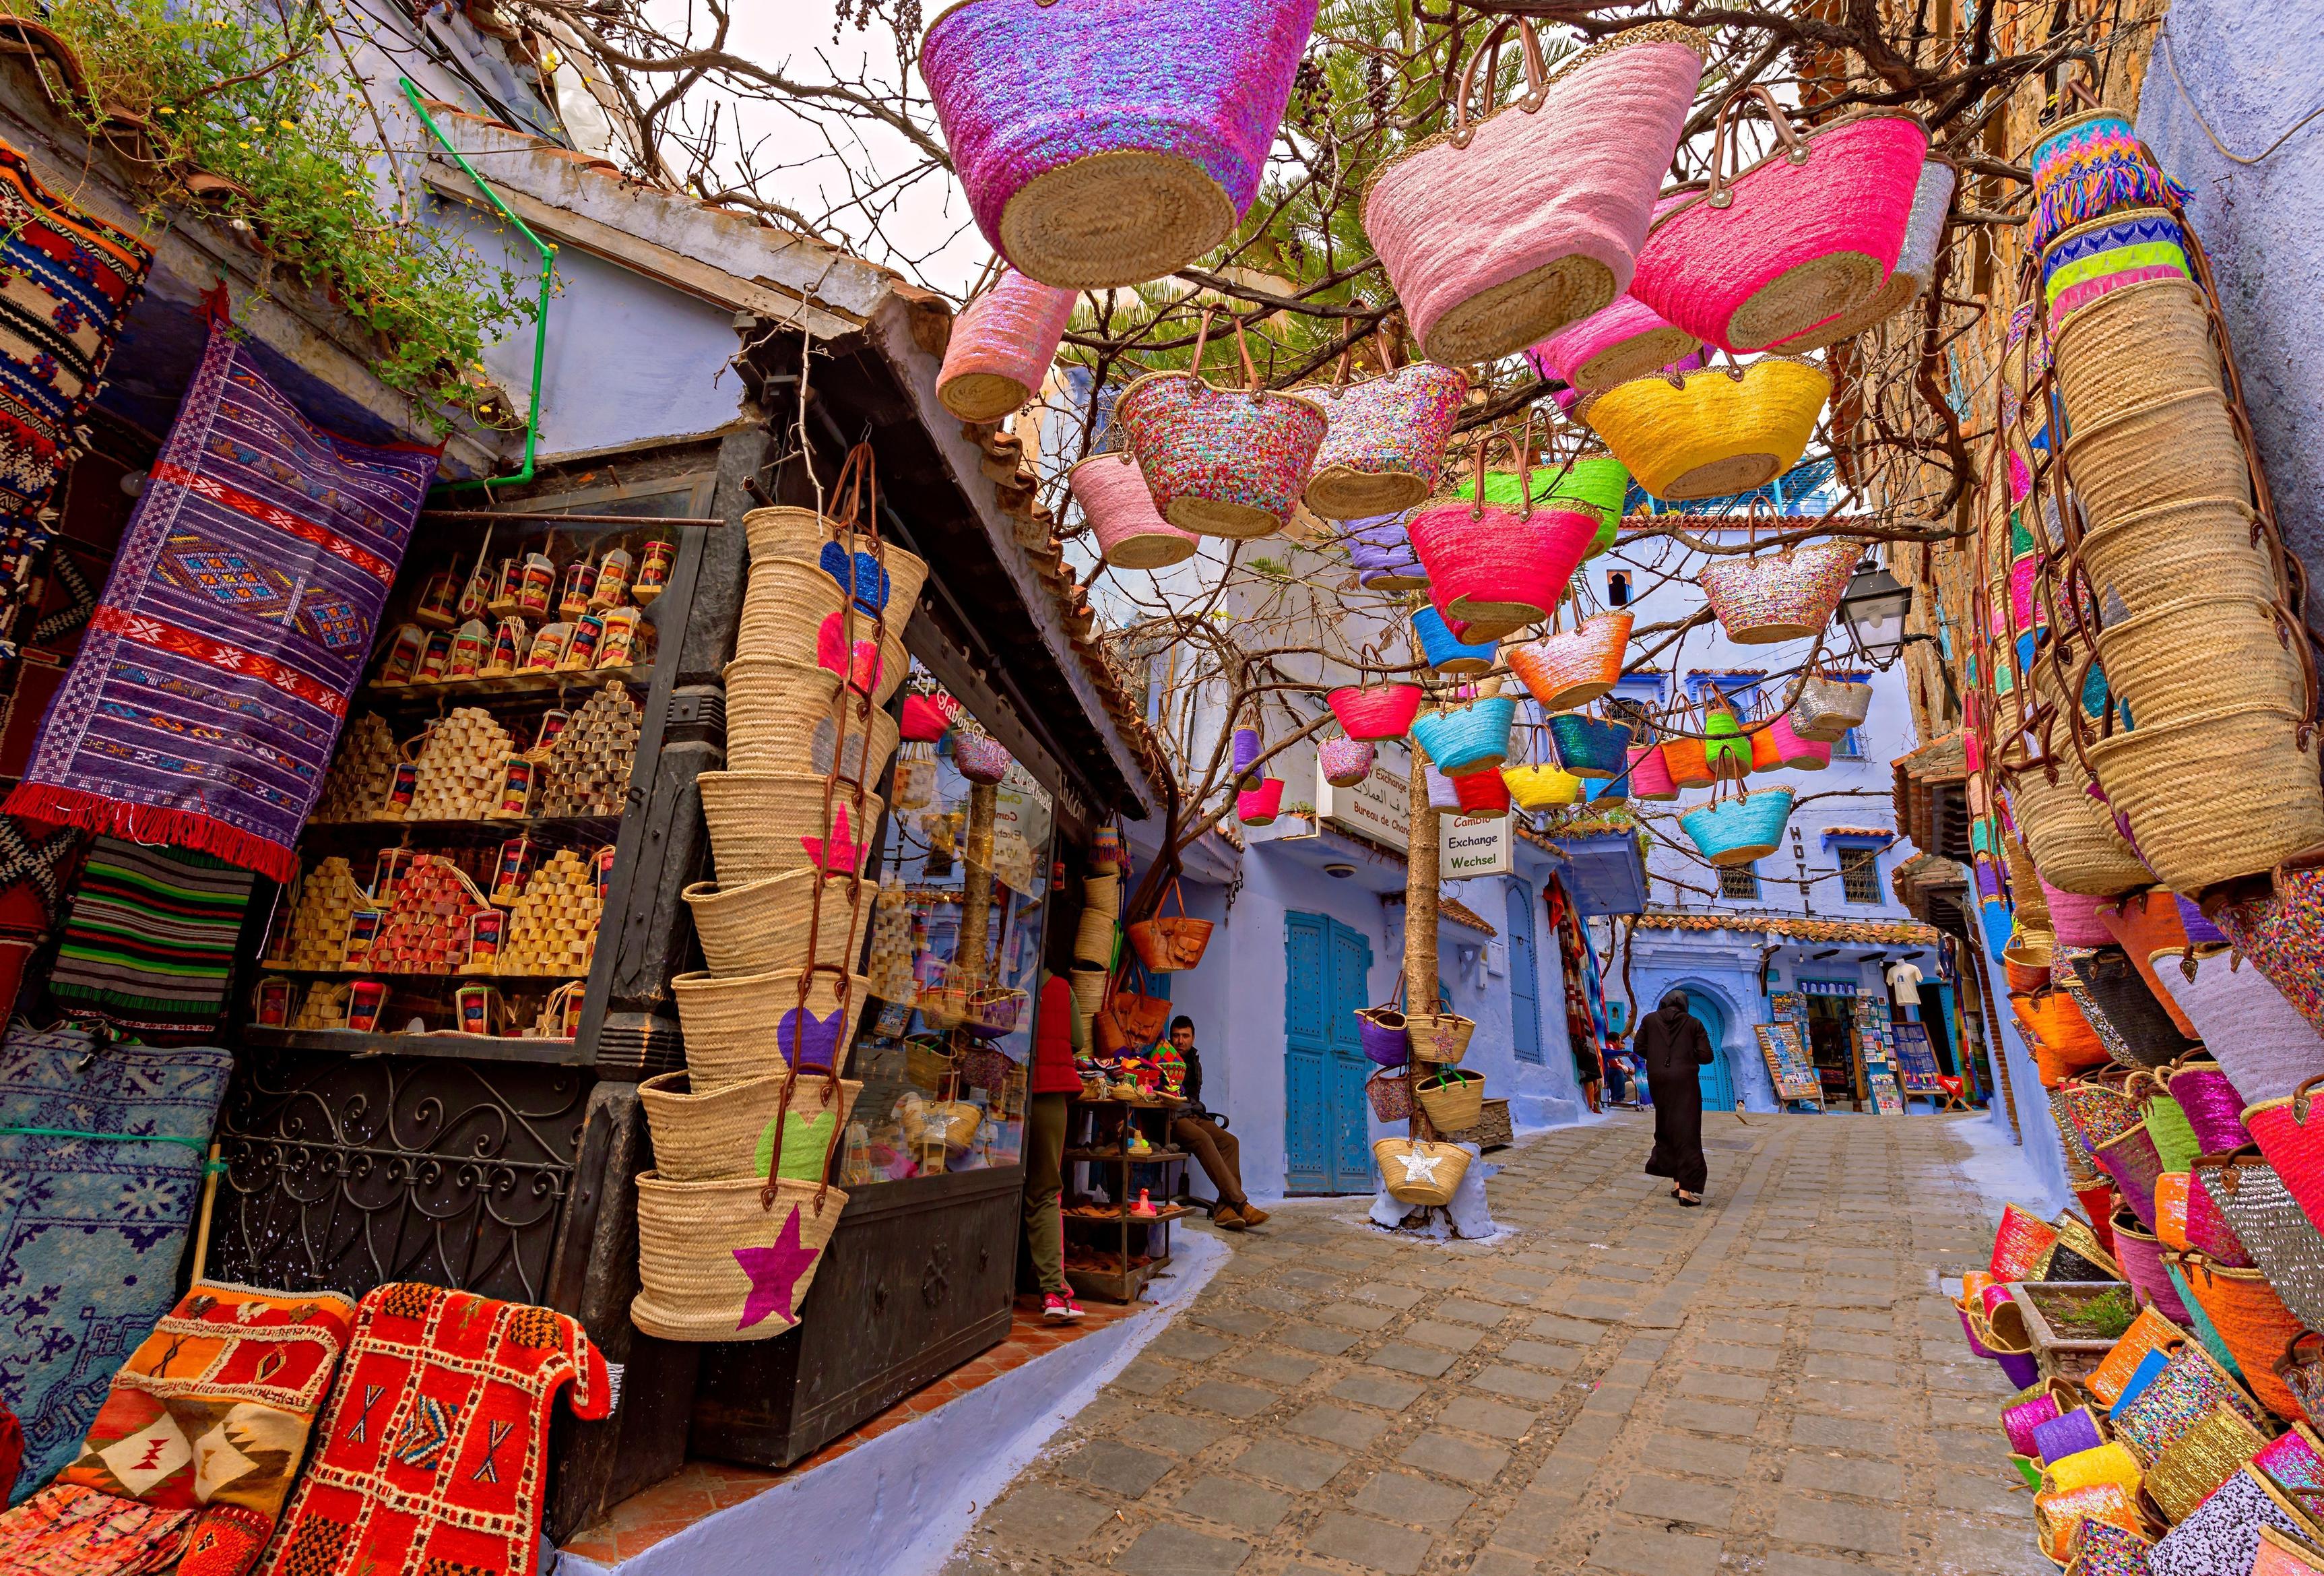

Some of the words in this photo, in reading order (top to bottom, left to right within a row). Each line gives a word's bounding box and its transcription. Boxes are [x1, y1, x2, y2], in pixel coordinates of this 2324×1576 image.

[911, 663, 932, 697] El
[1026, 776, 1052, 813] Abuela
[1376, 769, 1407, 794] Exchange
[1354, 800, 1378, 821] Bureau
[1380, 814, 1389, 827] de
[1448, 836, 1498, 849] Exchange
[1450, 853, 1496, 869] Wechsel
[1789, 826, 1816, 915] HOTEL
